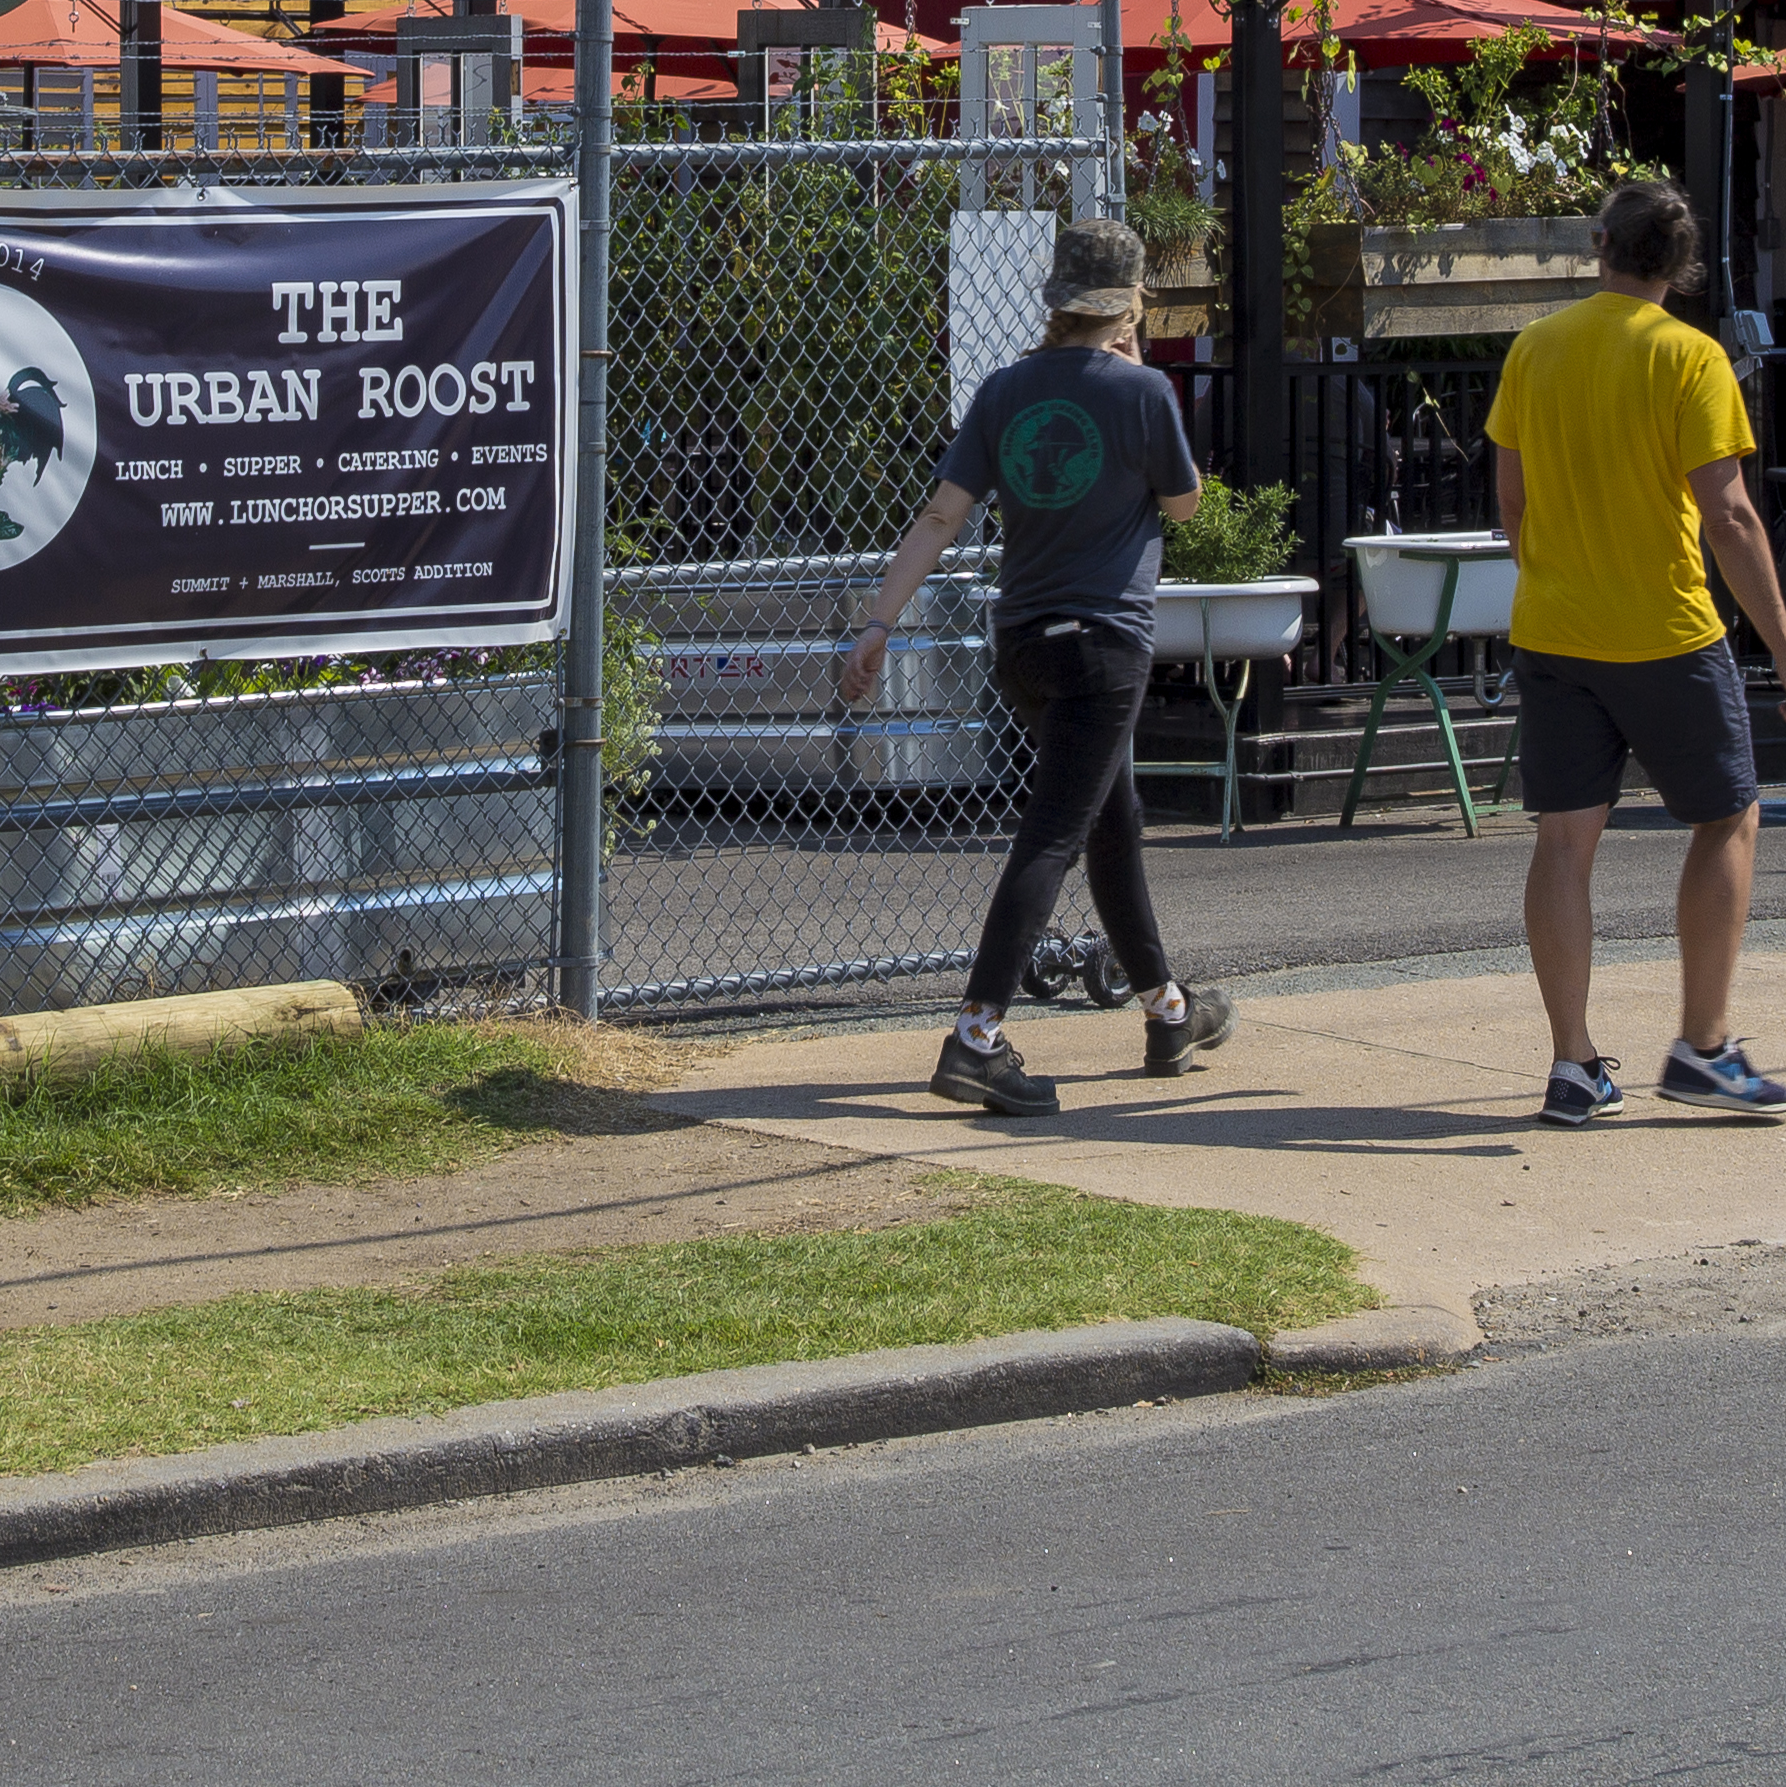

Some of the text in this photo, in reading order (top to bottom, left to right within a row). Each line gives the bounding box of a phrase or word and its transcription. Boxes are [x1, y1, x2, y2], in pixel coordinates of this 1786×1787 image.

[271, 279, 403, 344] THE
[124, 360, 535, 427] URBAN ROOST
[115, 444, 548, 481] LUNCH SUPPER CATERING EVENTS
[161, 487, 507, 527] WWW.LUNCHORSUPPER.COM
[171, 577, 230, 594] SUMMIT
[257, 572, 341, 590] MARSHALL,
[352, 567, 406, 584] SCOTTS
[413, 562, 494, 580] ADDITION
